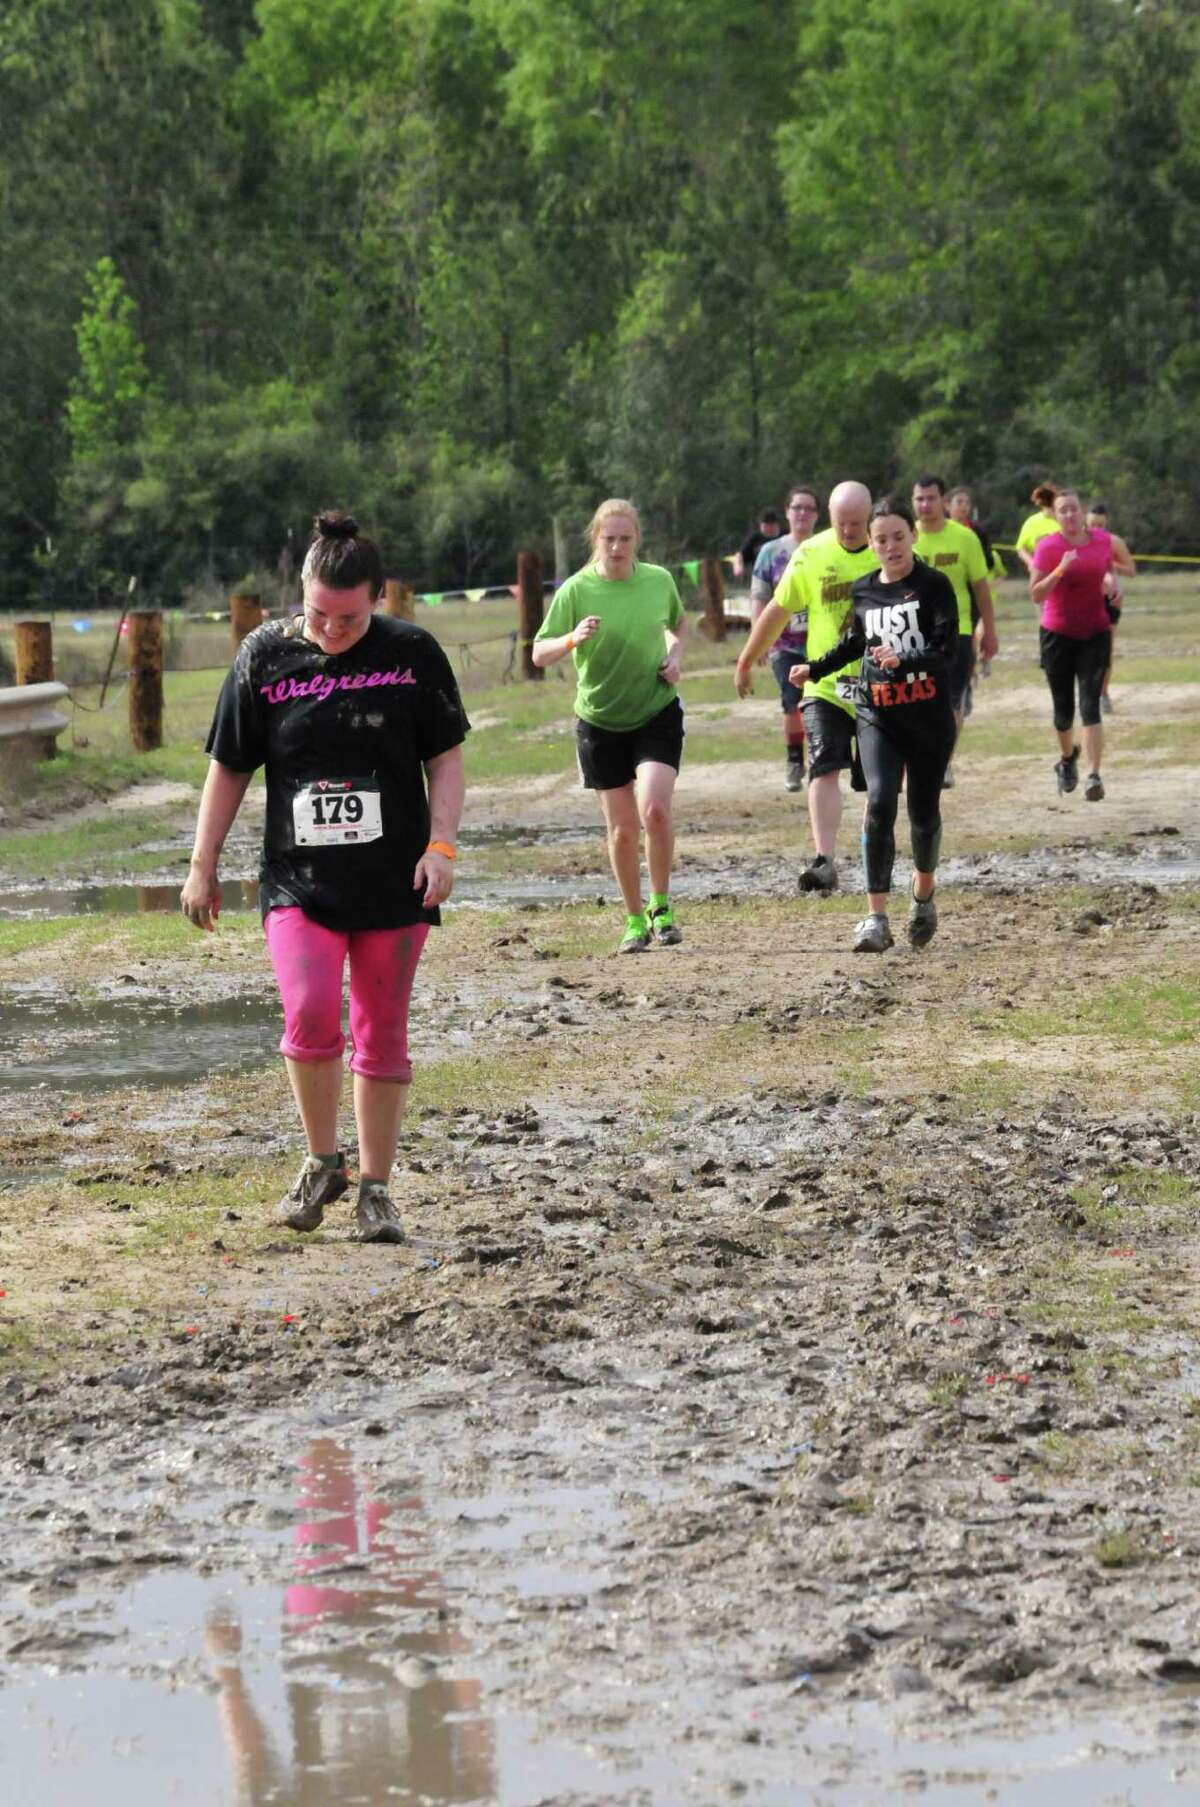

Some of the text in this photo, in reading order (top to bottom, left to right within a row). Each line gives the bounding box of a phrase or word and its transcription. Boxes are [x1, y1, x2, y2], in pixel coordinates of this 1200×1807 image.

[865, 600, 920, 640] JUST
[260, 667, 417, 704] Walgreens
[870, 677, 937, 706] TEXAS
[311, 794, 364, 825] 179
